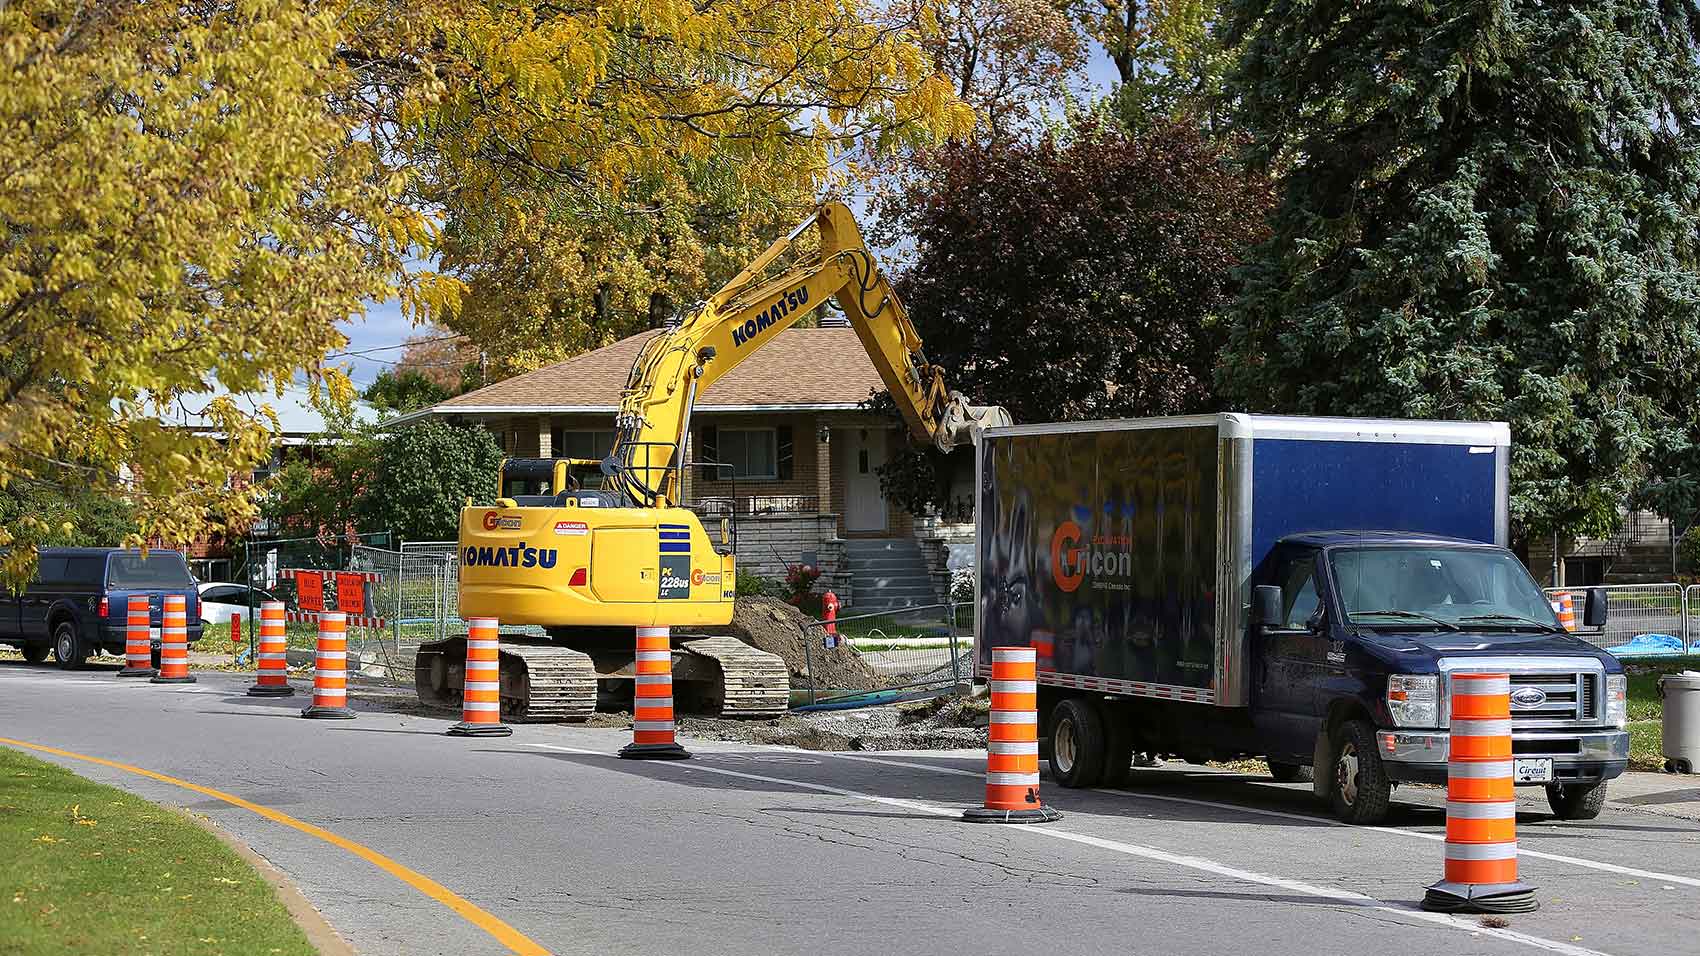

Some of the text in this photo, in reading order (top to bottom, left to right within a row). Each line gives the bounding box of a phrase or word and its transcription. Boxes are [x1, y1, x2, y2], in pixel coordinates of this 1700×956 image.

[732, 285, 809, 347] KOMATSU
[662, 567, 672, 576] PC
[1519, 765, 1546, 775] Circuit
